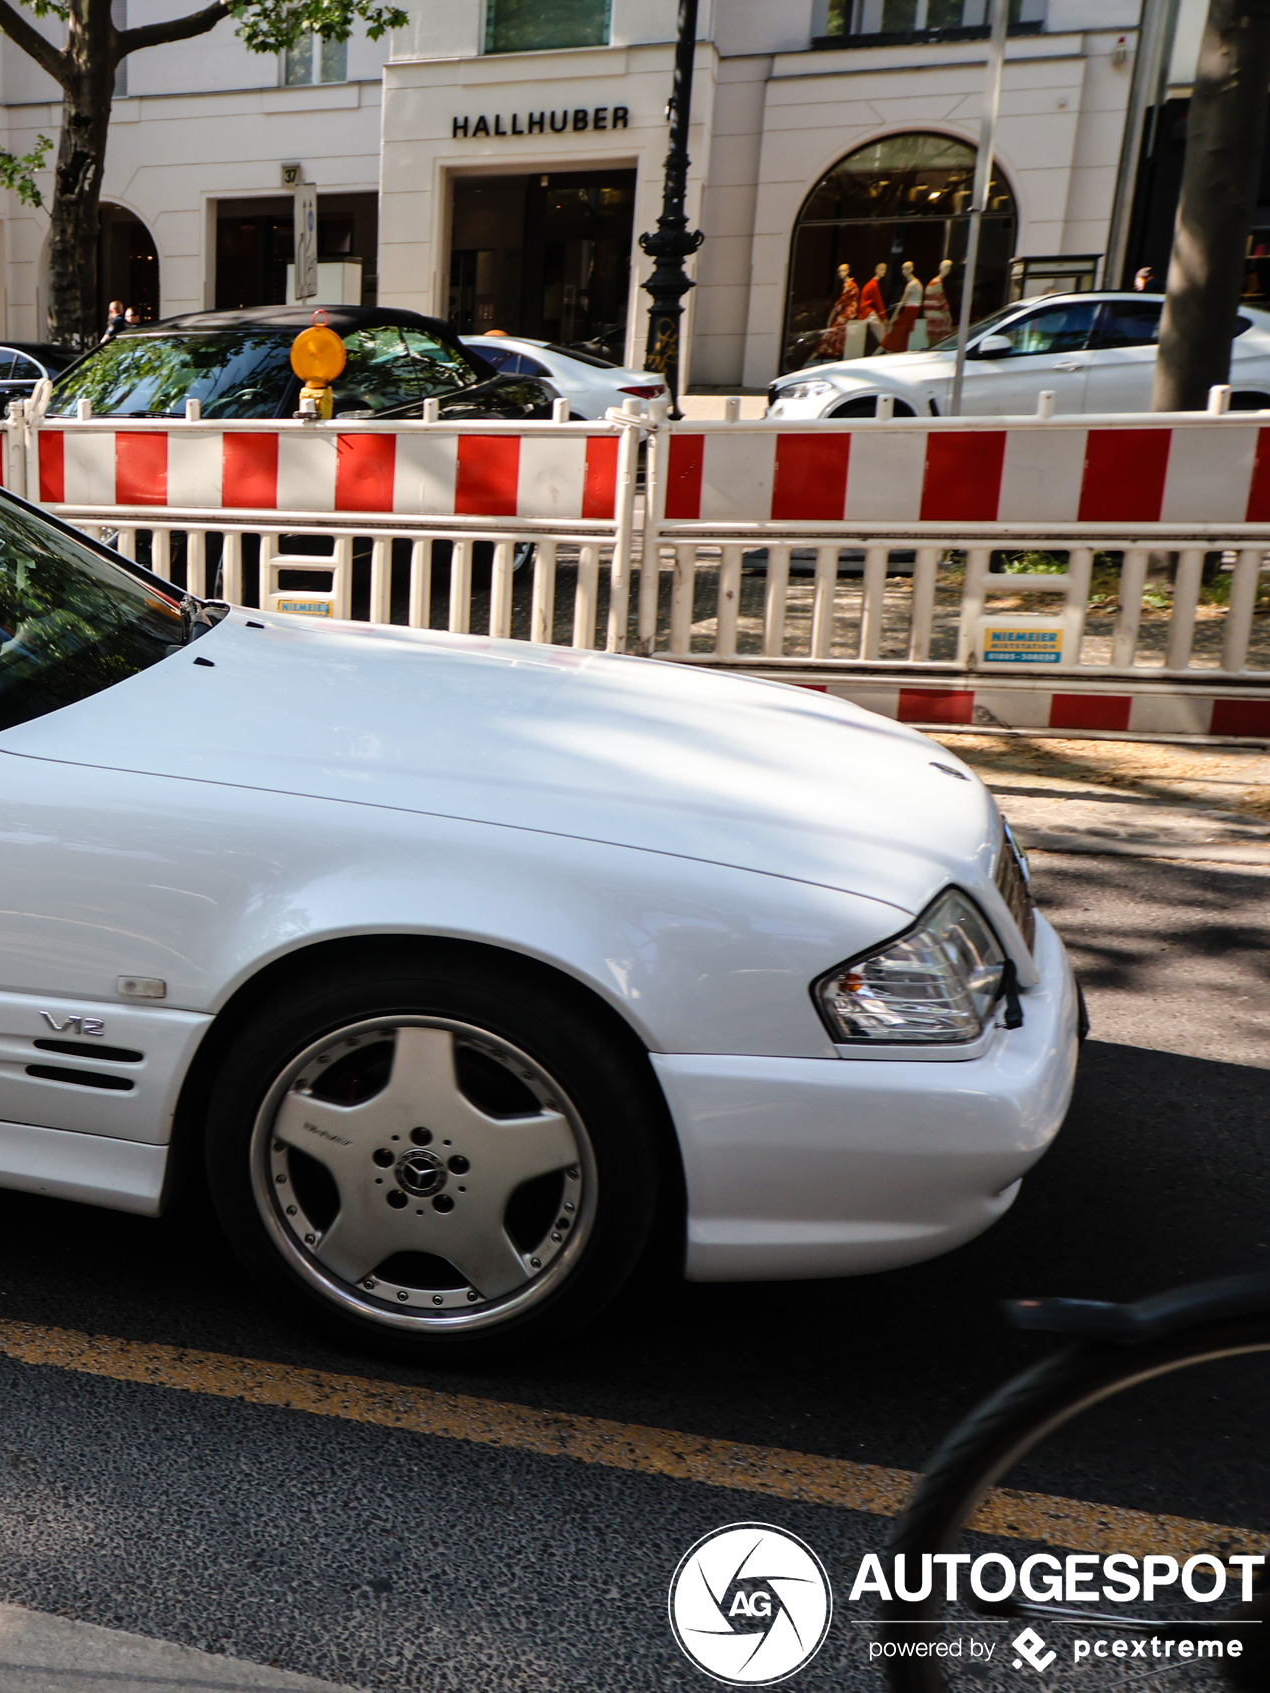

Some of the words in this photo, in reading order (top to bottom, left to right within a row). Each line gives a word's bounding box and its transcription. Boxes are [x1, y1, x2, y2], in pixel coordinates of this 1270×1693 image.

[452, 106, 629, 138] HALLHUBER
[284, 169, 297, 183] 37
[281, 603, 329, 612] NIEMEIER
[992, 632, 1057, 642] NIEMEIER
[39, 1010, 104, 1036] V12
